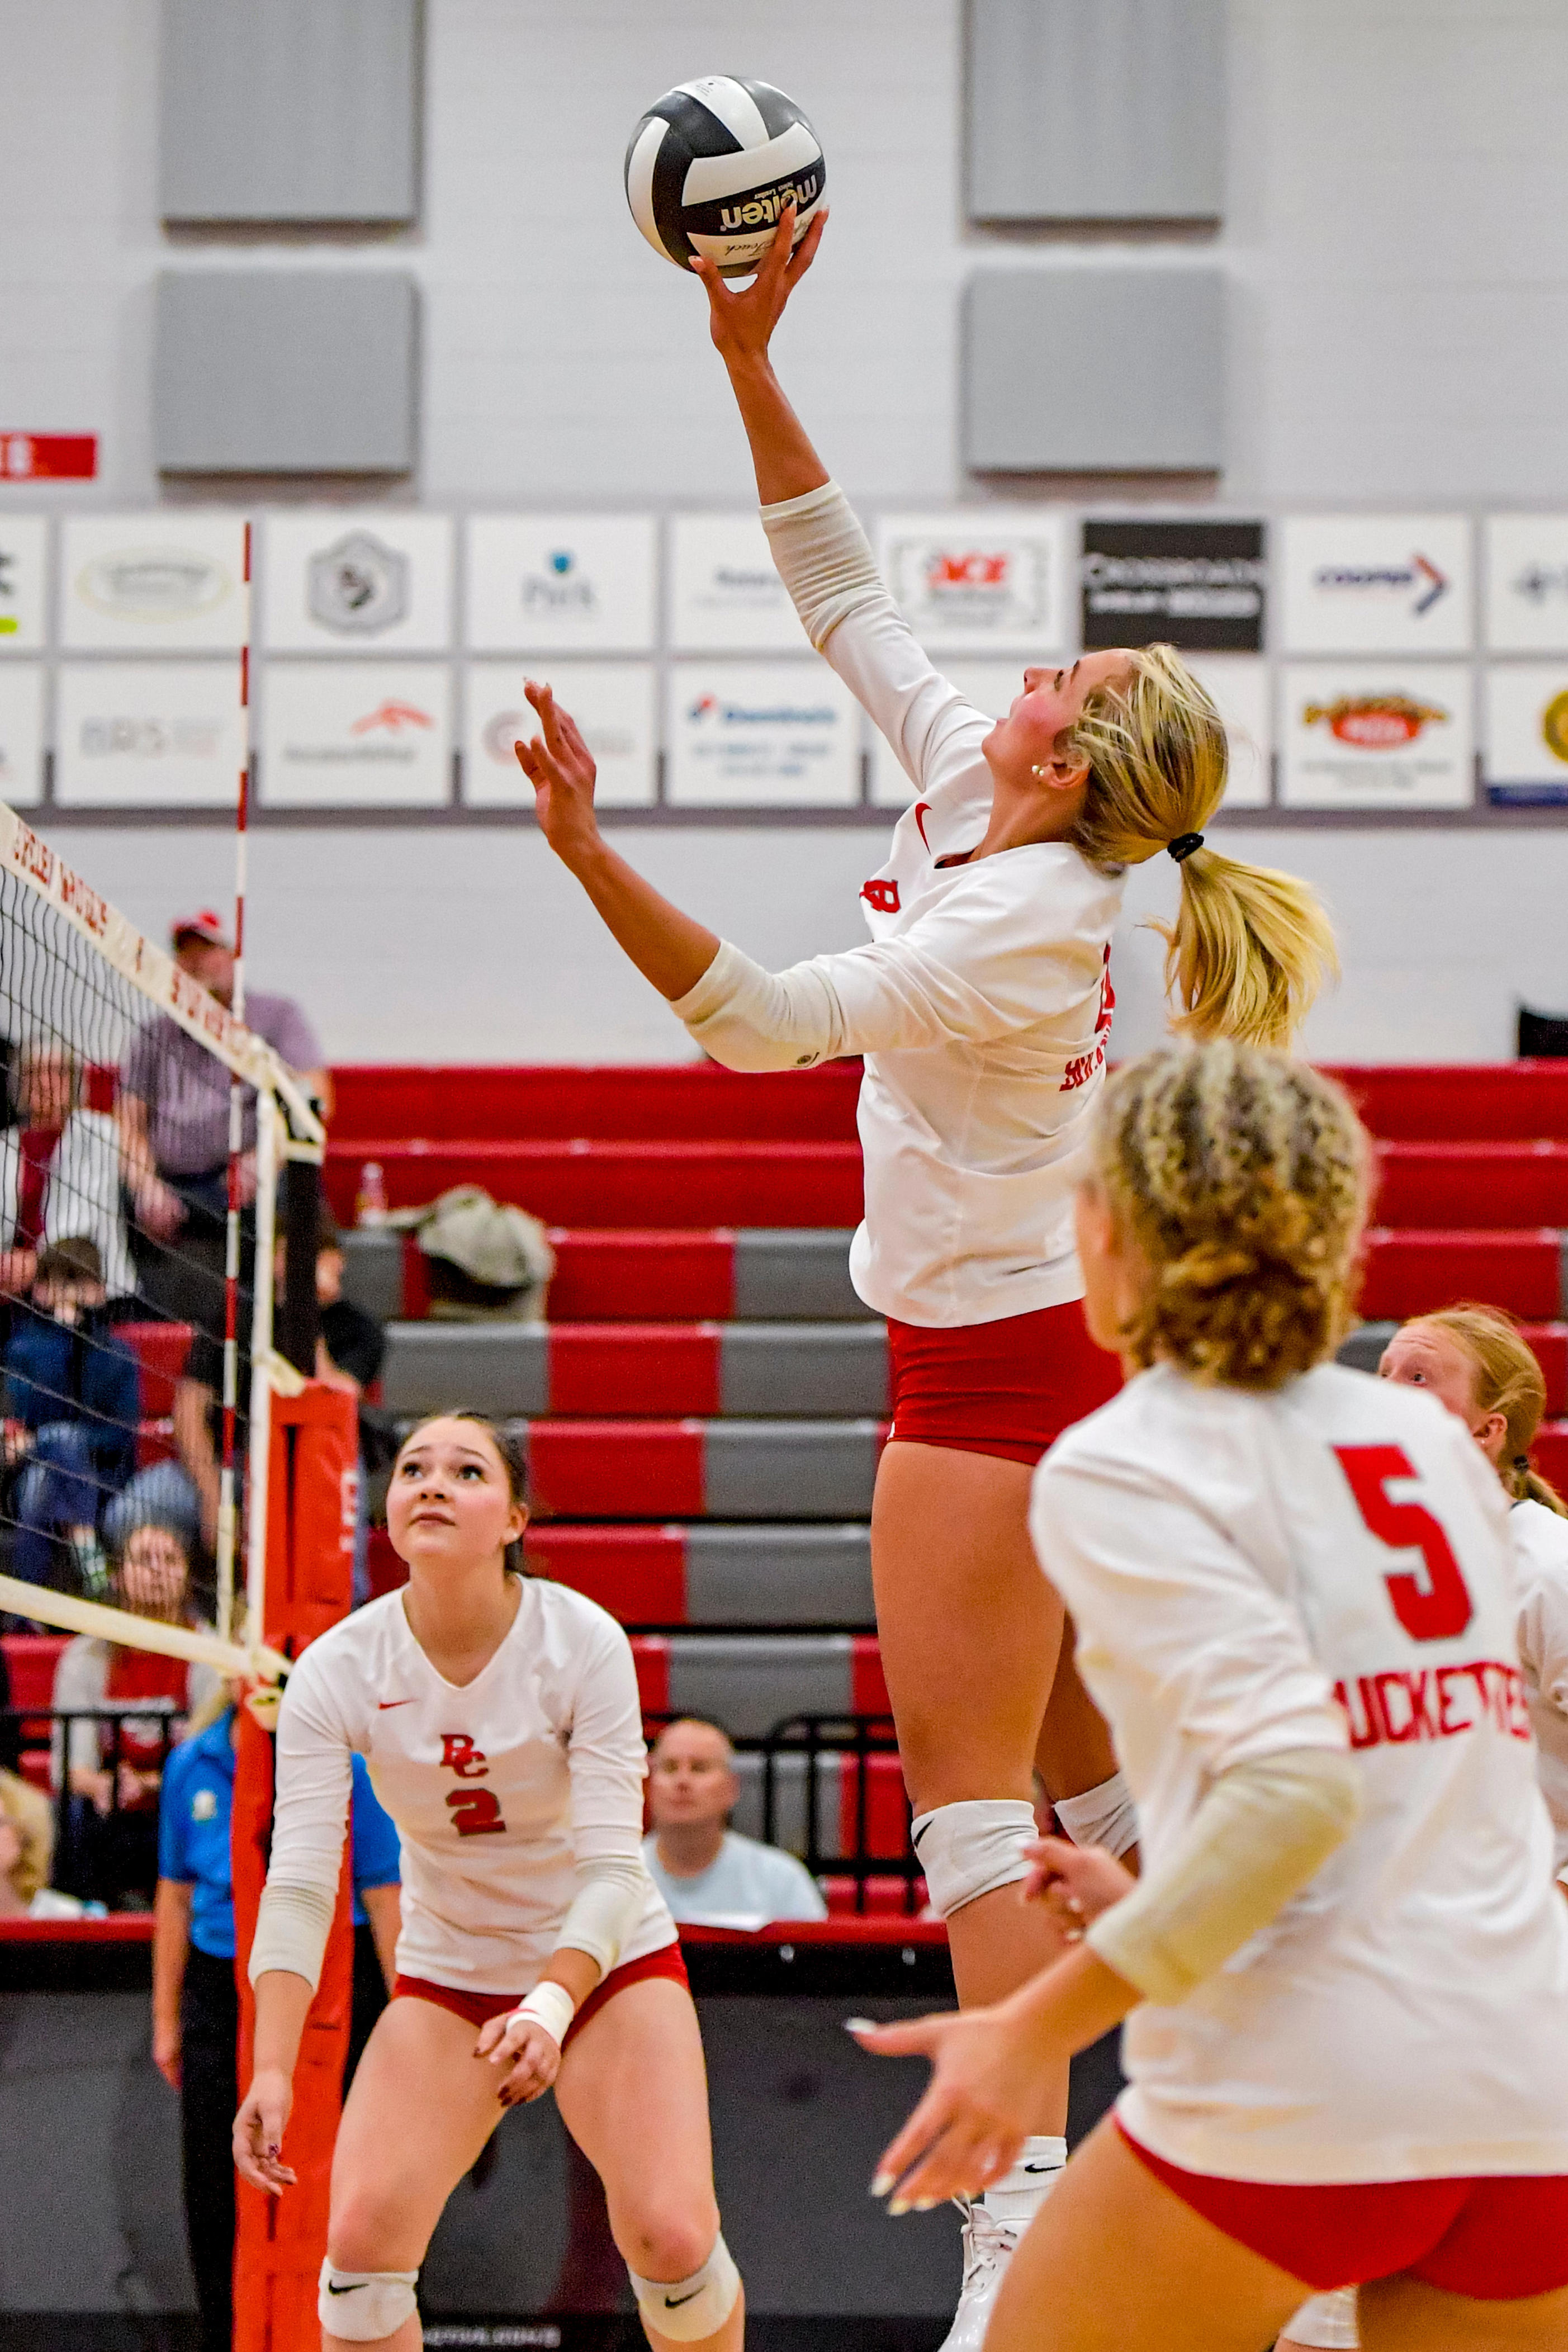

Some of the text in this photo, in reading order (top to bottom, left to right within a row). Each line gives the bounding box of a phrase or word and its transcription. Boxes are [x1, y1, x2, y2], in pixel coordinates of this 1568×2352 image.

[721, 174, 818, 229] molten
[726, 241, 770, 257] Touch
[1329, 1443, 1474, 1643] 5
[446, 1787, 507, 1838] 2
